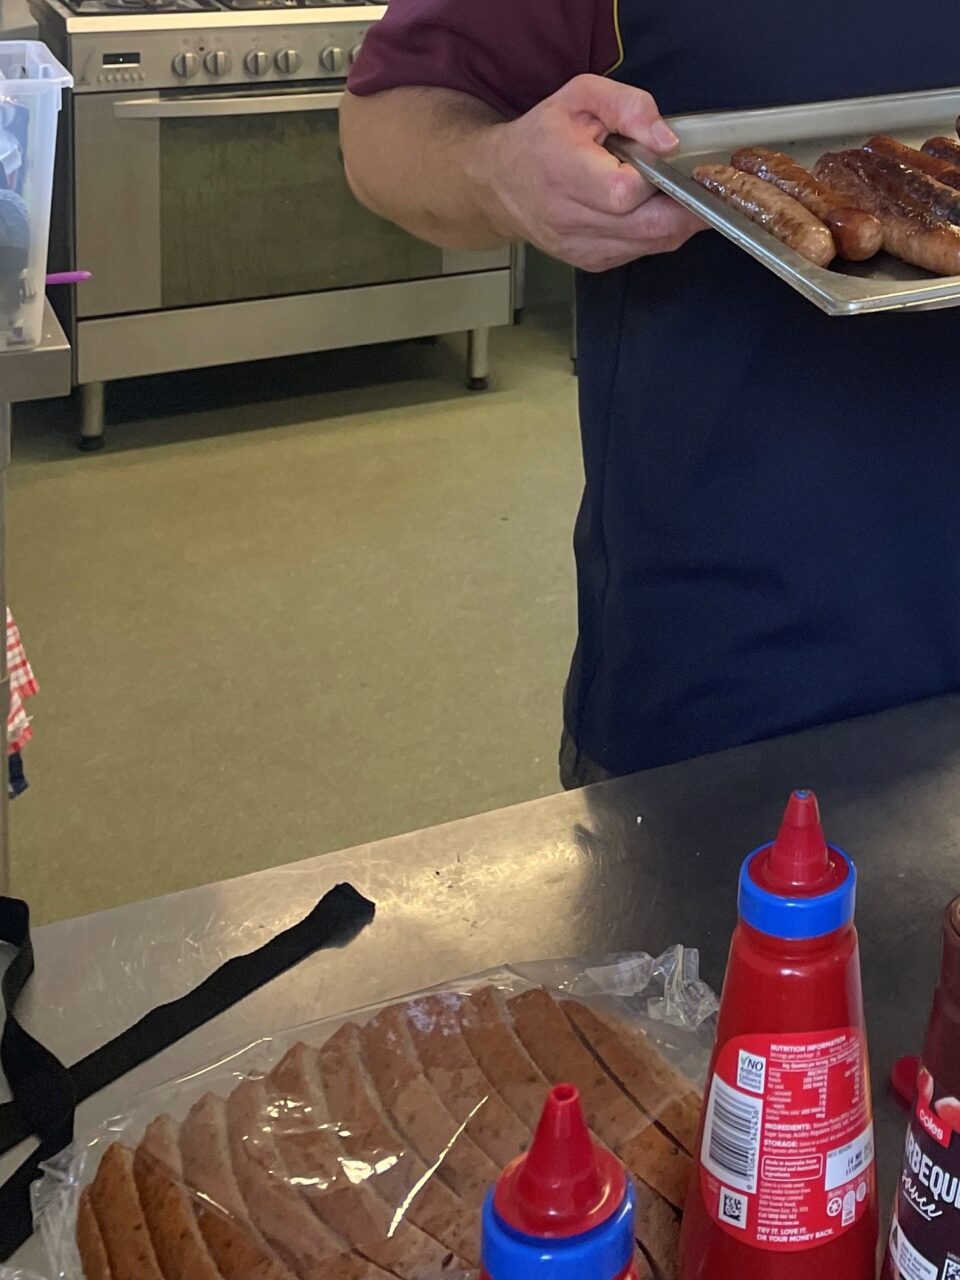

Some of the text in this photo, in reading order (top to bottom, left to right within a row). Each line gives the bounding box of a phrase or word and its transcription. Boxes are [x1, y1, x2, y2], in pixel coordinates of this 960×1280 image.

[770, 1044, 806, 1053] NUTRITION
[807, 1035, 846, 1051] INFORMATION
[747, 1058, 764, 1072] NO
[764, 1122, 812, 1131] INGREDIENTS:
[919, 1108, 944, 1141] coles
[763, 1139, 798, 1148] STORAGE:
[757, 1226, 808, 1235] TRY IT. LOVE IT.
[789, 1233, 814, 1242] MONEY
[815, 1228, 835, 1239] BACK.
